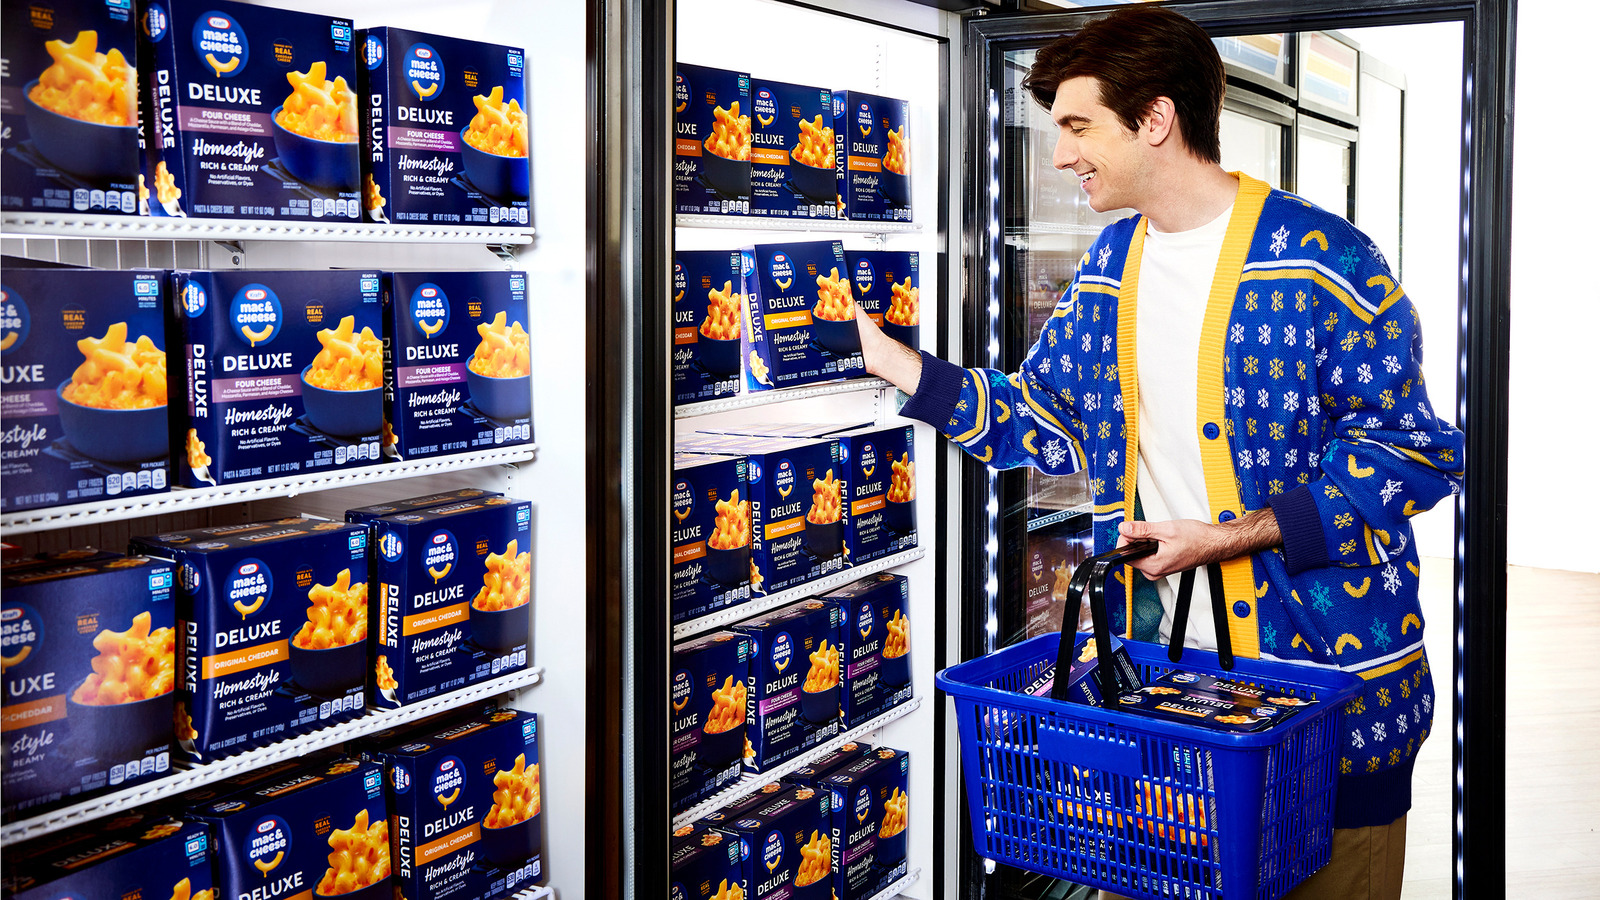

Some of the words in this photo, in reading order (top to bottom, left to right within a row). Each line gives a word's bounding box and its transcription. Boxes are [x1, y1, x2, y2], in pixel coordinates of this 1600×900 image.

[274, 47, 292, 56] REAL
[464, 74, 478, 82] REAL
[189, 83, 262, 105] DELUXE
[158, 69, 176, 149] DELUXE
[202, 111, 222, 119] FOUR
[224, 113, 251, 121] CHEESE
[398, 106, 453, 125] DELUXE
[371, 94, 383, 163] DELUXE
[407, 130, 424, 138] FOUR
[425, 132, 444, 140] CHEESE
[192, 138, 264, 163] Homestyle
[836, 134, 845, 180] DELUXE
[853, 142, 878, 154] DELUXE
[228, 163, 258, 171] CREAMY
[398, 154, 454, 176] Homestyle
[425, 176, 449, 184] CREAMY
[852, 174, 879, 186] Homestyle
[769, 295, 806, 310] DELUXE
[1034, 300, 1052, 309] DELUXE
[63, 313, 84, 322] REAL
[748, 292, 763, 342] DELUXE
[771, 317, 788, 325] ORIGINAL
[773, 330, 810, 348] Homestyle
[223, 352, 292, 372] DELUXE
[406, 344, 459, 361] DELUXE
[416, 367, 430, 375] FOUR
[193, 344, 207, 418] DELUXE
[235, 380, 255, 388] FOUR
[256, 378, 282, 386] CHEESE
[408, 389, 461, 408] Homestyle
[225, 403, 293, 425] Homestyle
[414, 410, 427, 418] RICH
[434, 407, 456, 415] CREAMY
[232, 428, 249, 436] RICH
[251, 427, 256, 435] &
[258, 424, 287, 434] CREAMY
[856, 481, 882, 496] DELUXE
[770, 502, 801, 518] DELUXE
[752, 501, 762, 550] DELUXE
[770, 526, 786, 534] ORIGINAL
[786, 521, 801, 530] CHEDDAR
[856, 514, 882, 529] Homestyle
[771, 536, 802, 554] Homestyle
[414, 584, 464, 609] DELUXE
[1028, 583, 1049, 597] DELUXE
[388, 584, 399, 648] DELUXE
[412, 616, 438, 628] ORIGINAL
[438, 609, 462, 622] CHEDDAR
[216, 620, 281, 648] DELUXE
[412, 628, 462, 654] Homestyle
[186, 622, 197, 694] DELUXE
[214, 657, 247, 669] ORIGINAL
[248, 649, 279, 662] CHEDDAR
[416, 655, 429, 664] RICH
[436, 646, 457, 658] CREAMY
[853, 640, 878, 659] DELUXE
[214, 669, 280, 699] Homestyle
[766, 673, 798, 694] DELUXE
[852, 672, 879, 692] Homestyle
[1024, 667, 1056, 695] DELU
[1213, 681, 1265, 696] DELUXE
[219, 701, 237, 710] RICH
[245, 690, 273, 702] CREAMY
[747, 676, 756, 726] DELUXE
[1080, 681, 1097, 706] DELUXE
[1181, 695, 1234, 710] DELUXE
[765, 707, 797, 729] Homestyle
[1160, 701, 1214, 716] DELUXE
[484, 762, 496, 770] REAL
[314, 820, 330, 829] REAL
[424, 806, 474, 837] DELUXE
[848, 821, 875, 844] DELUXE
[399, 816, 411, 879] DELUXE
[424, 841, 449, 857] ORIGINAL
[450, 831, 473, 846] CHEDDAR
[831, 827, 840, 874] DELUXE
[424, 850, 475, 882] Homestyle
[429, 880, 443, 891] RICH
[444, 877, 448, 885] &
[449, 868, 471, 883] CREAMY
[757, 869, 790, 896] DELUXE
